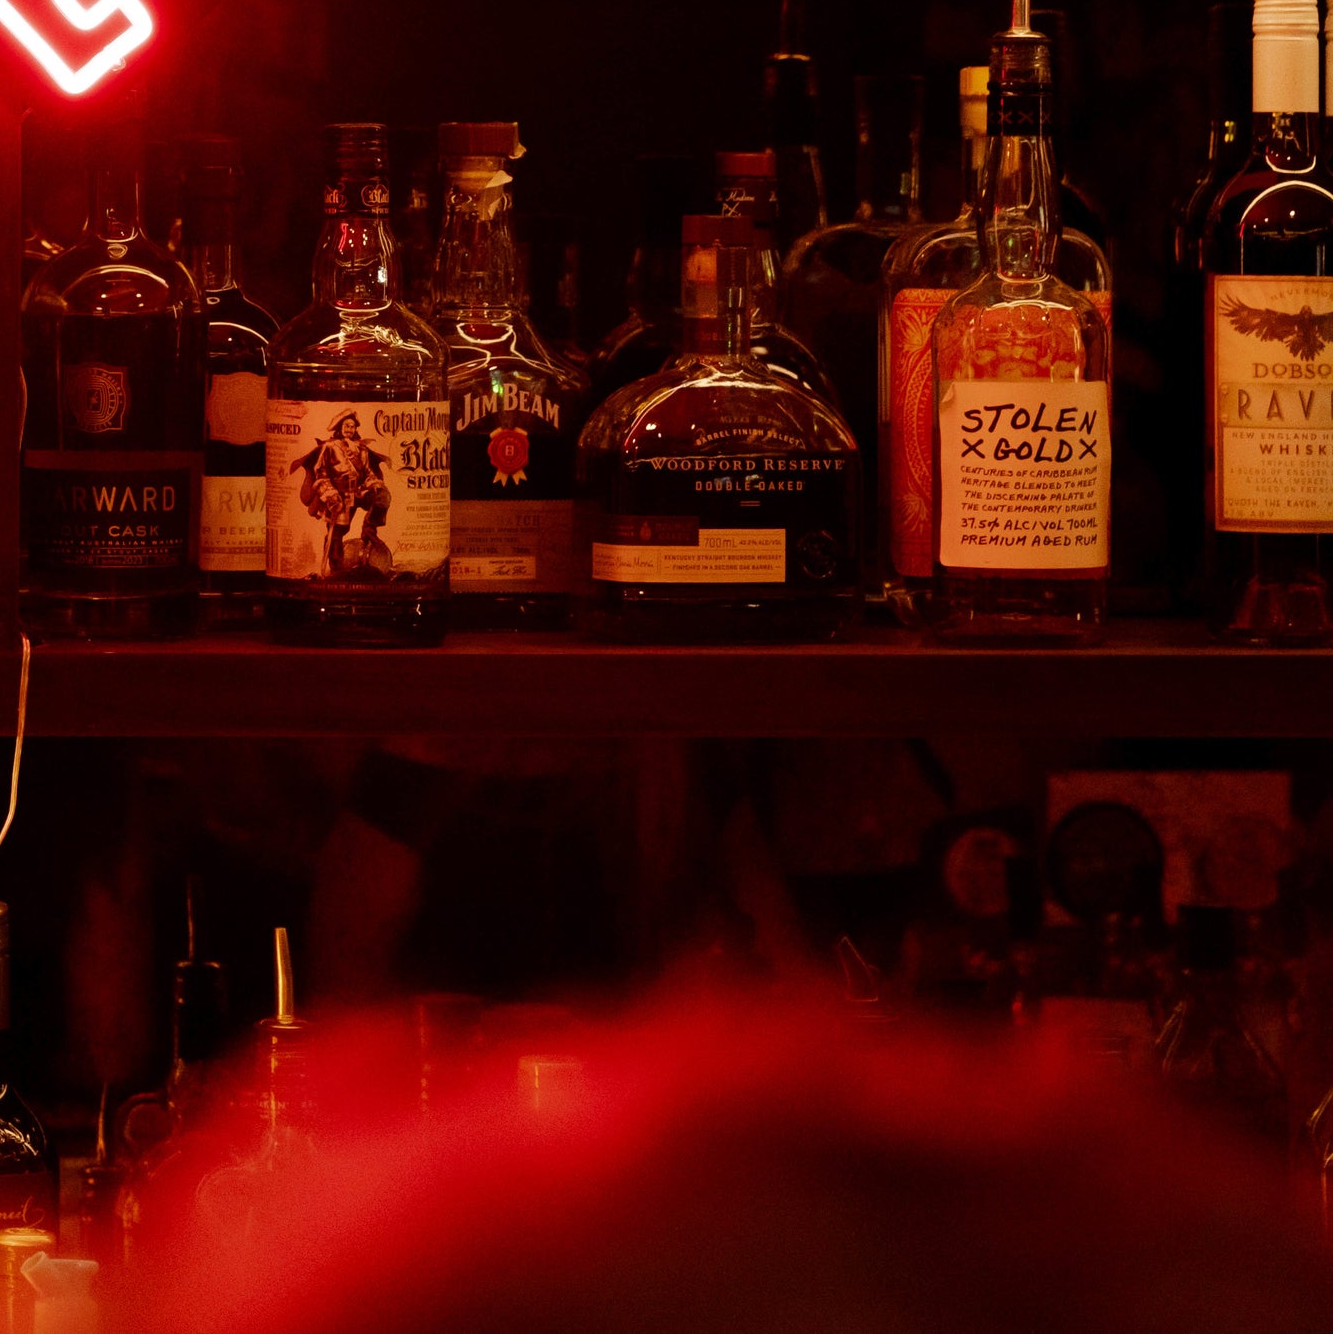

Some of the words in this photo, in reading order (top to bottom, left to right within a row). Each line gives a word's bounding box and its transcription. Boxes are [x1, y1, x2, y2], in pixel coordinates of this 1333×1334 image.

[456, 392, 498, 432] JIM
[502, 382, 561, 431] BEAM
[1237, 388, 1333, 421] RAV
[374, 409, 424, 437] Captain
[961, 403, 1097, 435] STOLEN
[695, 430, 730, 447] BARREL
[732, 428, 764, 437] FINISH
[767, 430, 801, 447] SELECT
[1261, 432, 1318, 441] ENGLAND
[961, 438, 985, 459] X
[994, 437, 1073, 463] GOLD
[1079, 438, 1097, 460] X
[650, 457, 756, 472] WOODFORD
[764, 457, 845, 472] RESERVE
[960, 466, 1013, 477] CENTURIES
[1016, 469, 1028, 477] OF
[1029, 467, 1083, 478] CARIBBEAN
[1084, 464, 1098, 475] RUM
[695, 480, 752, 492] DOUBLE
[758, 480, 804, 492] OAKED
[961, 477, 1010, 489] HERITAGE
[1014, 481, 1062, 490] BLENDED
[1064, 480, 1076, 488] TO
[1077, 477, 1097, 488] MEET
[964, 490, 982, 499] THE
[985, 491, 1048, 501] DISCERNING
[1049, 491, 1085, 501] PALATE
[961, 502, 979, 512] THE
[981, 504, 1063, 514] CONTEMPORARY
[1065, 502, 1097, 513] DRINKER
[108, 524, 160, 538] CASK
[219, 526, 256, 535] BEER
[961, 517, 1000, 532] 37.5%
[1004, 519, 1064, 531] ALC/VOL
[1067, 517, 1098, 530] 700ML
[960, 534, 1027, 547] PREMIUM
[1032, 535, 1072, 547] AGED
[1075, 534, 1097, 546] RUM
